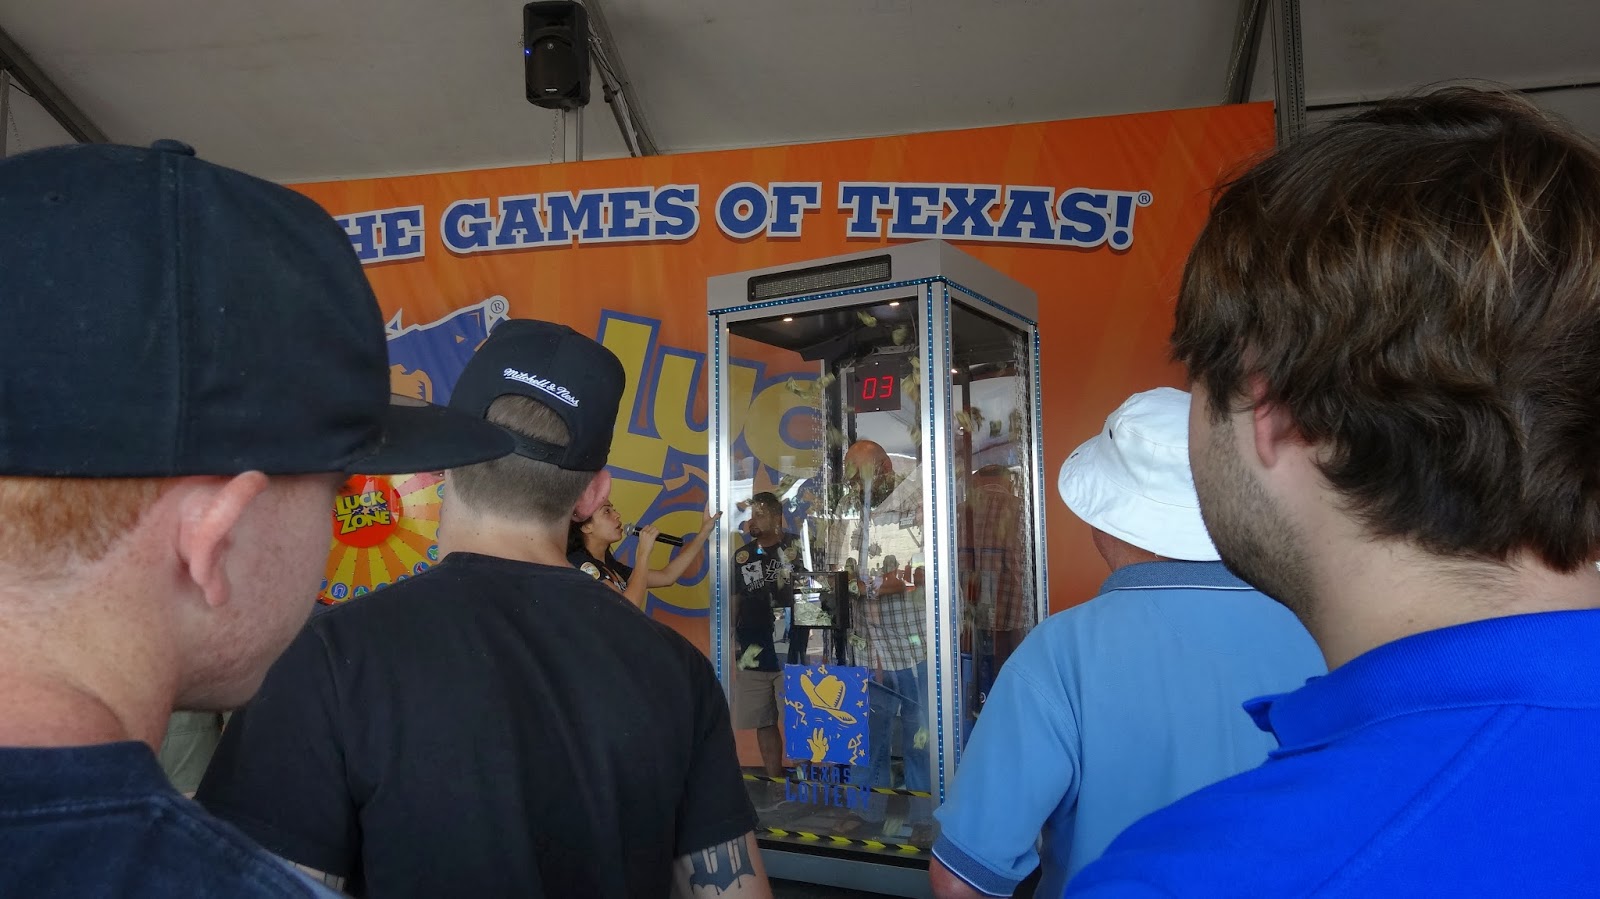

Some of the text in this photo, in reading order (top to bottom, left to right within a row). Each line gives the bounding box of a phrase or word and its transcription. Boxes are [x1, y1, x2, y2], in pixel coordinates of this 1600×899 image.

[334, 207, 423, 262] HE
[442, 186, 698, 252] GAMES
[717, 184, 820, 237] OF
[503, 367, 580, 405] Mitchell & Ness
[862, 375, 894, 400] 03
[335, 491, 387, 515] LUCK
[336, 511, 391, 534] ZONE
[800, 763, 852, 785] TEXAS
[785, 776, 871, 811] LOTTERY
